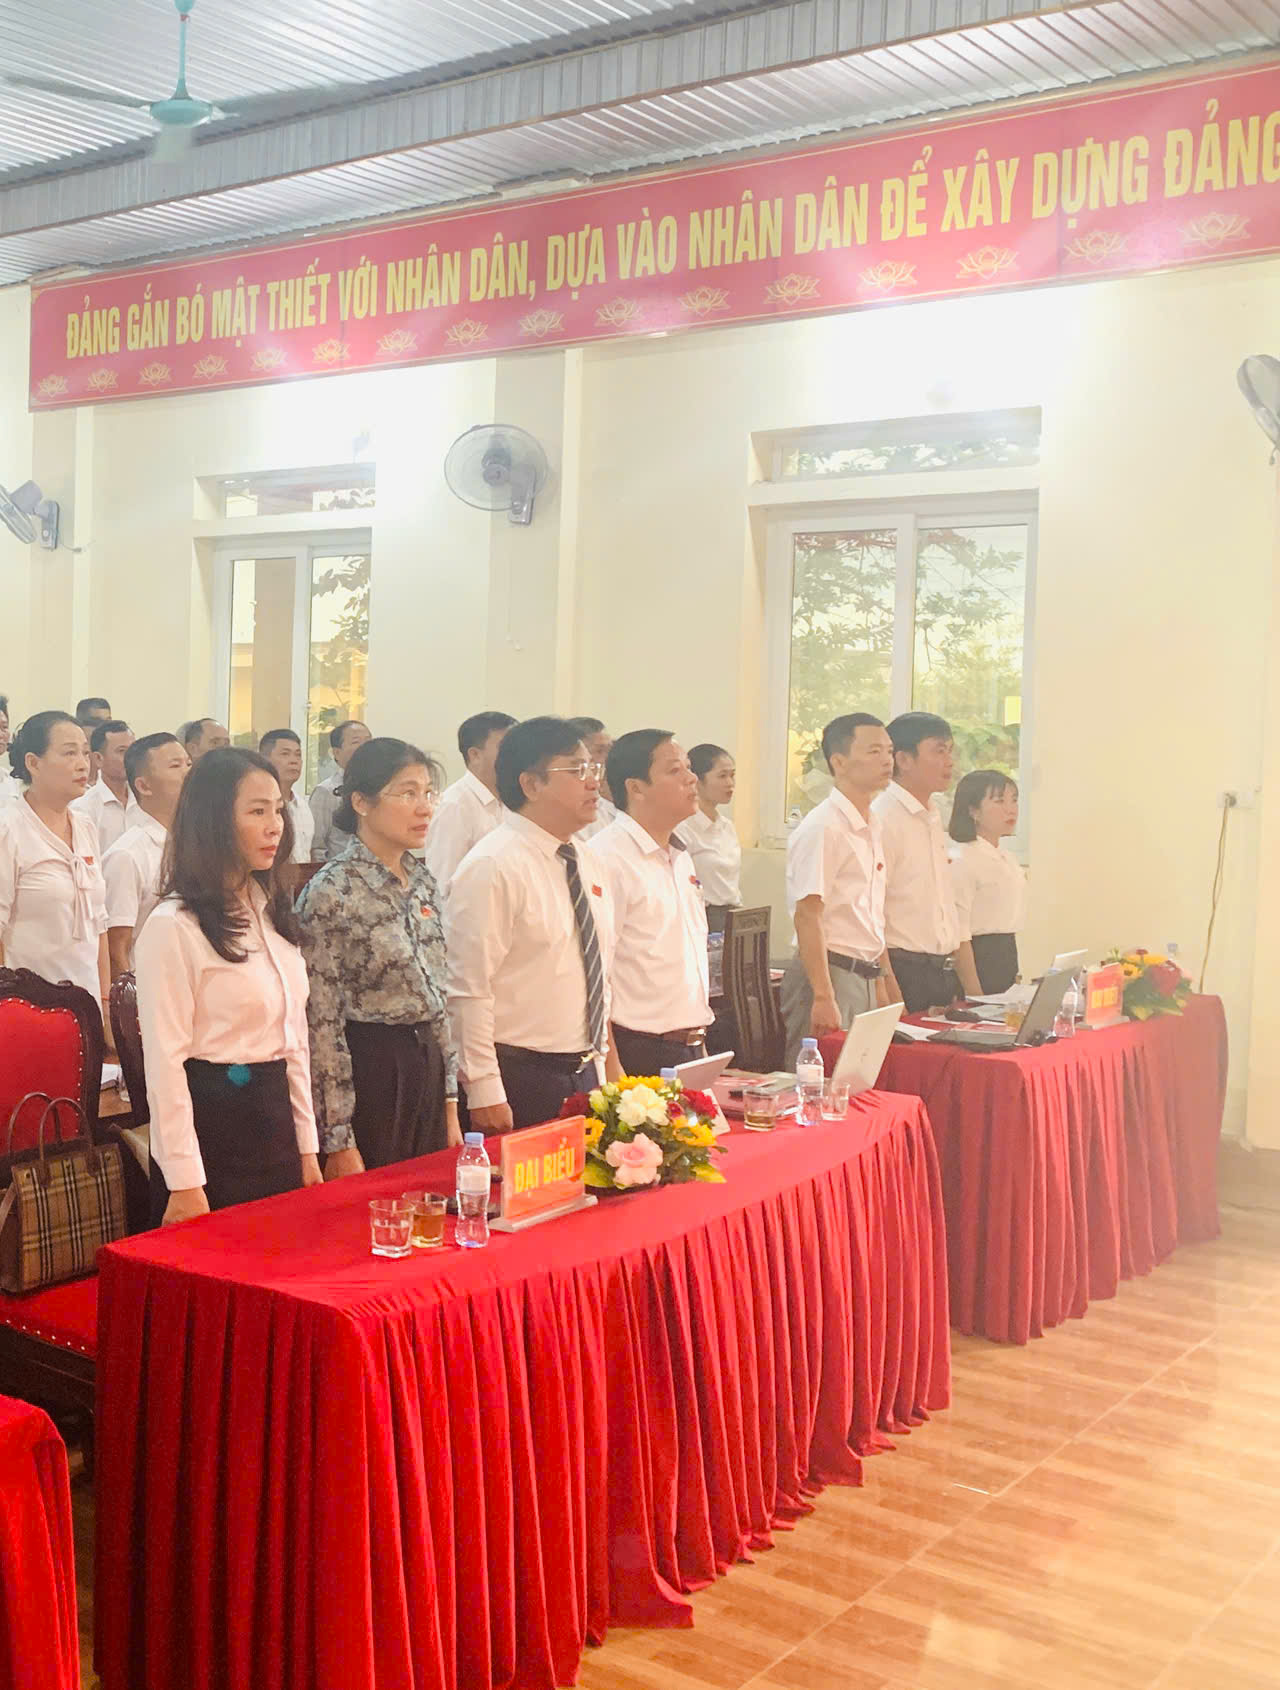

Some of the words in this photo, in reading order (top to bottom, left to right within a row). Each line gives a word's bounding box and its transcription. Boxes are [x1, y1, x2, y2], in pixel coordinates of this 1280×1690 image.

[67, 295, 120, 358] ĐẢNG
[126, 283, 169, 351] GẮN
[176, 283, 204, 345] BÓ
[212, 275, 260, 347] MẬT
[267, 258, 331, 331] THIẾT
[338, 255, 377, 321] VỚI
[387, 243, 461, 314] NHÂN
[470, 232, 536, 301] DÂN,
[546, 224, 606, 300] DỰA
[617, 207, 678, 280] VÀO
[689, 190, 782, 270] NHÂN
[795, 175, 869, 255] DÂN
[880, 145, 932, 241] ĐỂ
[940, 148, 1019, 232] XÂY
[1032, 136, 1149, 229] DỰNG
[1164, 98, 1280, 198] ĐẢNG
